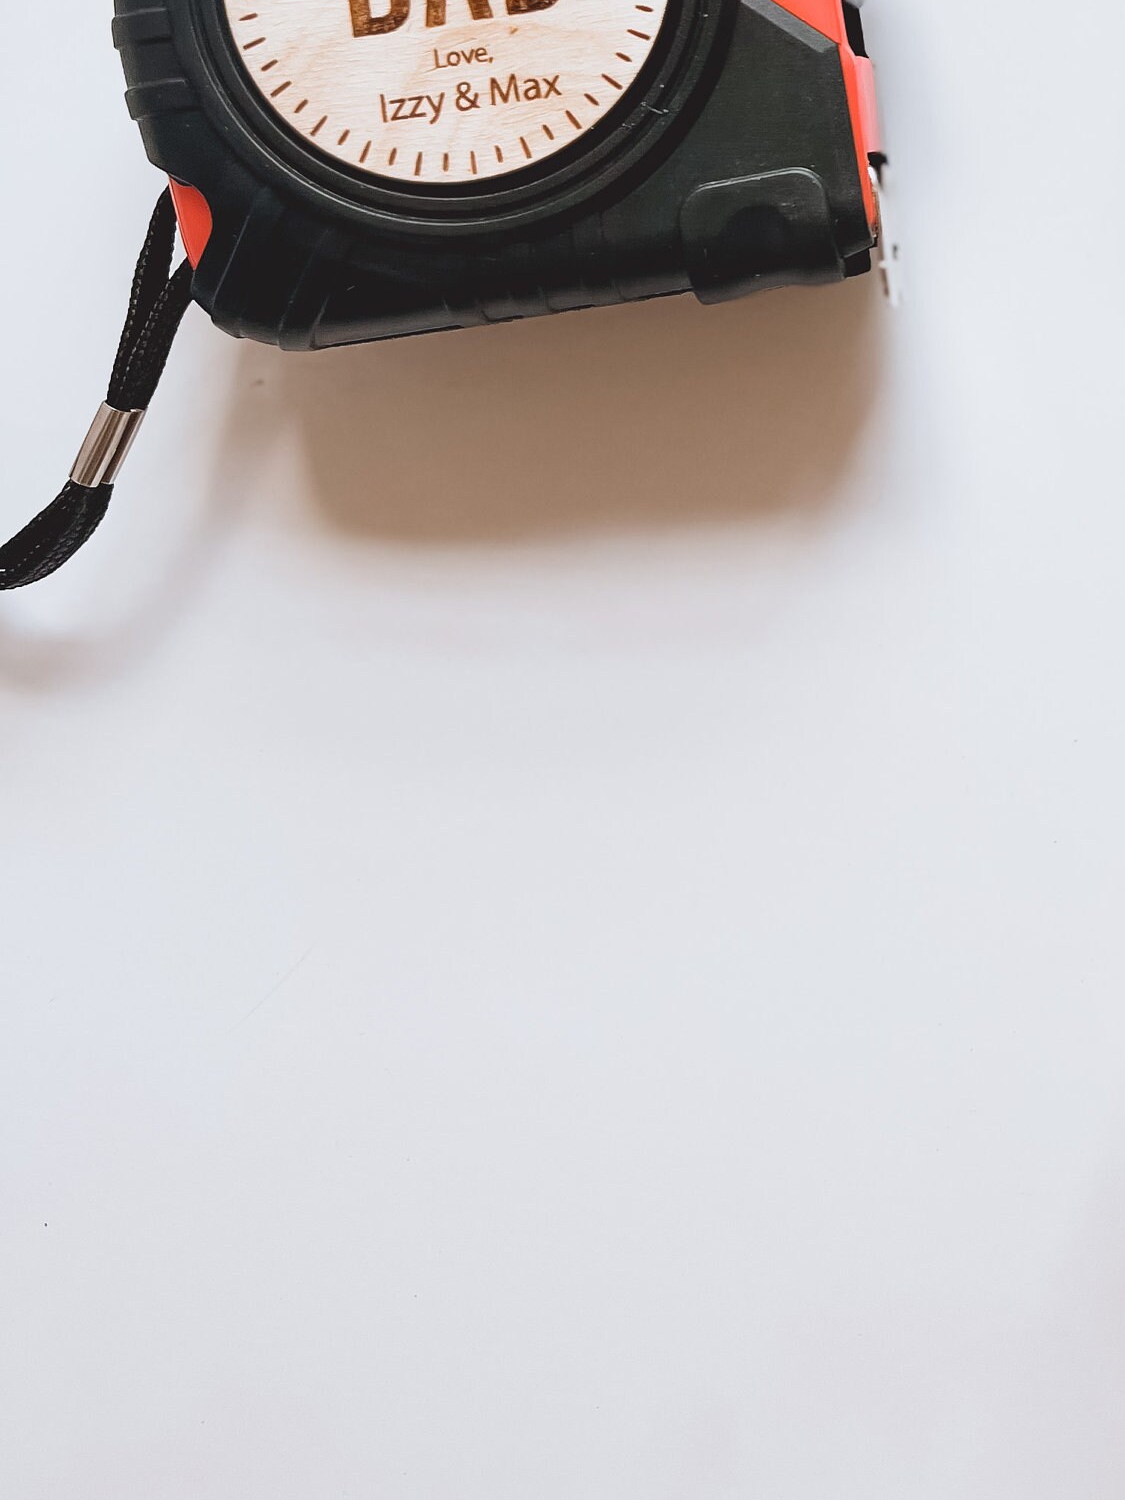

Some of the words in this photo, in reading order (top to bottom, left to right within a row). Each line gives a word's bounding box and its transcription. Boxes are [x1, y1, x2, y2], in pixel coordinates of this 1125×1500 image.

[433, 47, 494, 69] Love,
[379, 92, 446, 124] Izzy
[454, 81, 480, 111] &
[489, 74, 562, 106] Max
